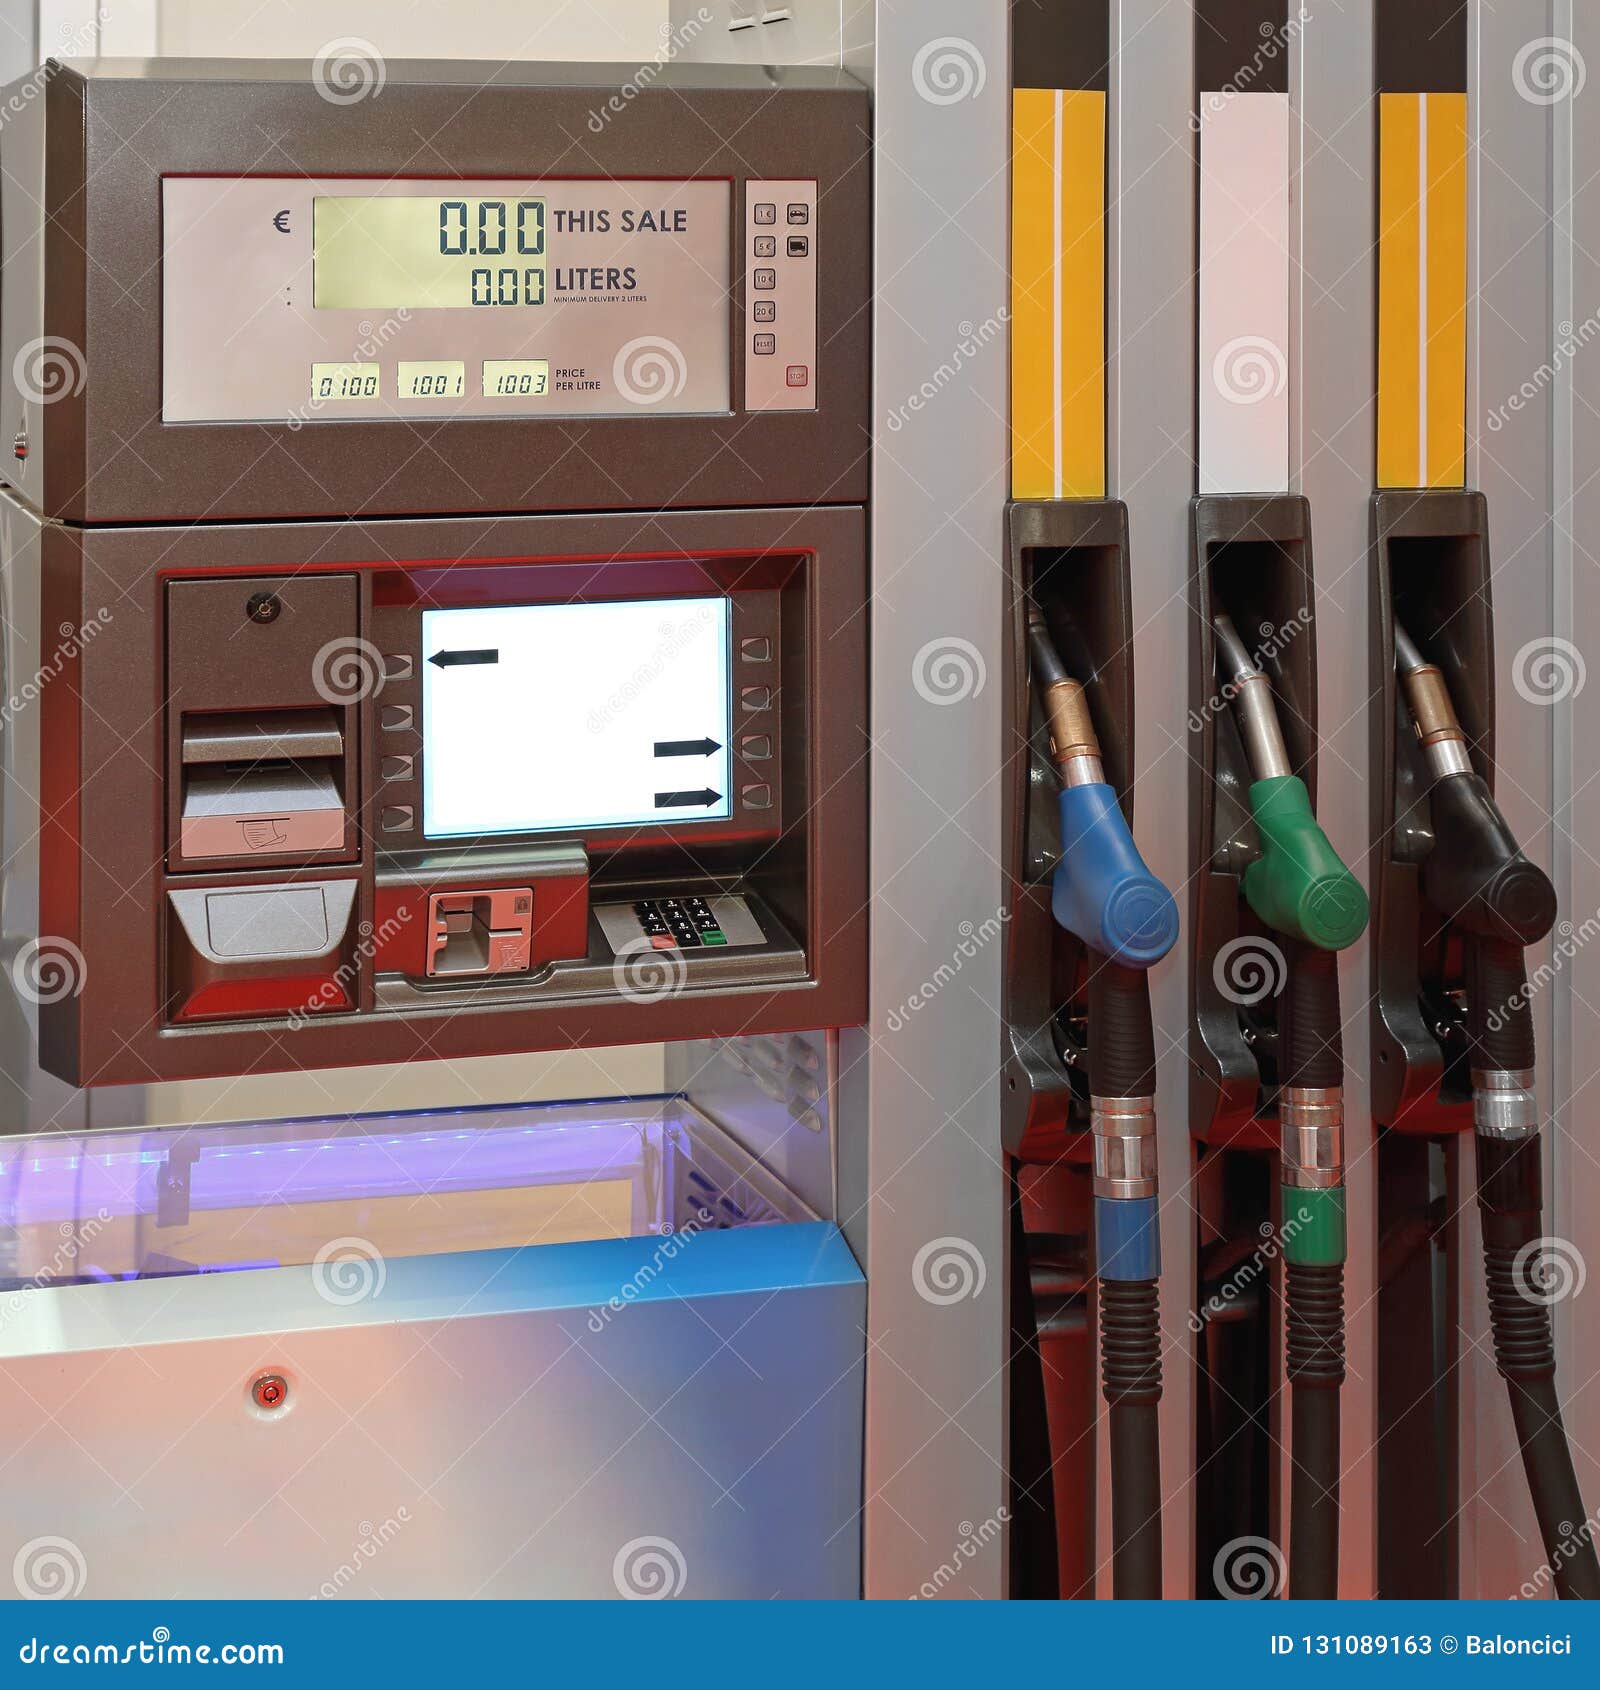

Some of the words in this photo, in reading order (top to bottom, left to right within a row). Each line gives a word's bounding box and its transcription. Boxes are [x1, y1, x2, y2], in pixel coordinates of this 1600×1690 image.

[273, 209, 291, 233] €
[439, 201, 545, 255] 0.00
[553, 210, 611, 233] THIS
[620, 210, 687, 232] SALE
[471, 268, 545, 306] 0.00
[555, 267, 637, 290] LITERS
[555, 369, 585, 378] PRICE
[319, 377, 376, 396] 0.100
[412, 376, 462, 395] 1.001
[497, 375, 546, 394] 1.003
[555, 381, 574, 391] PER
[576, 381, 600, 390] LITRE
